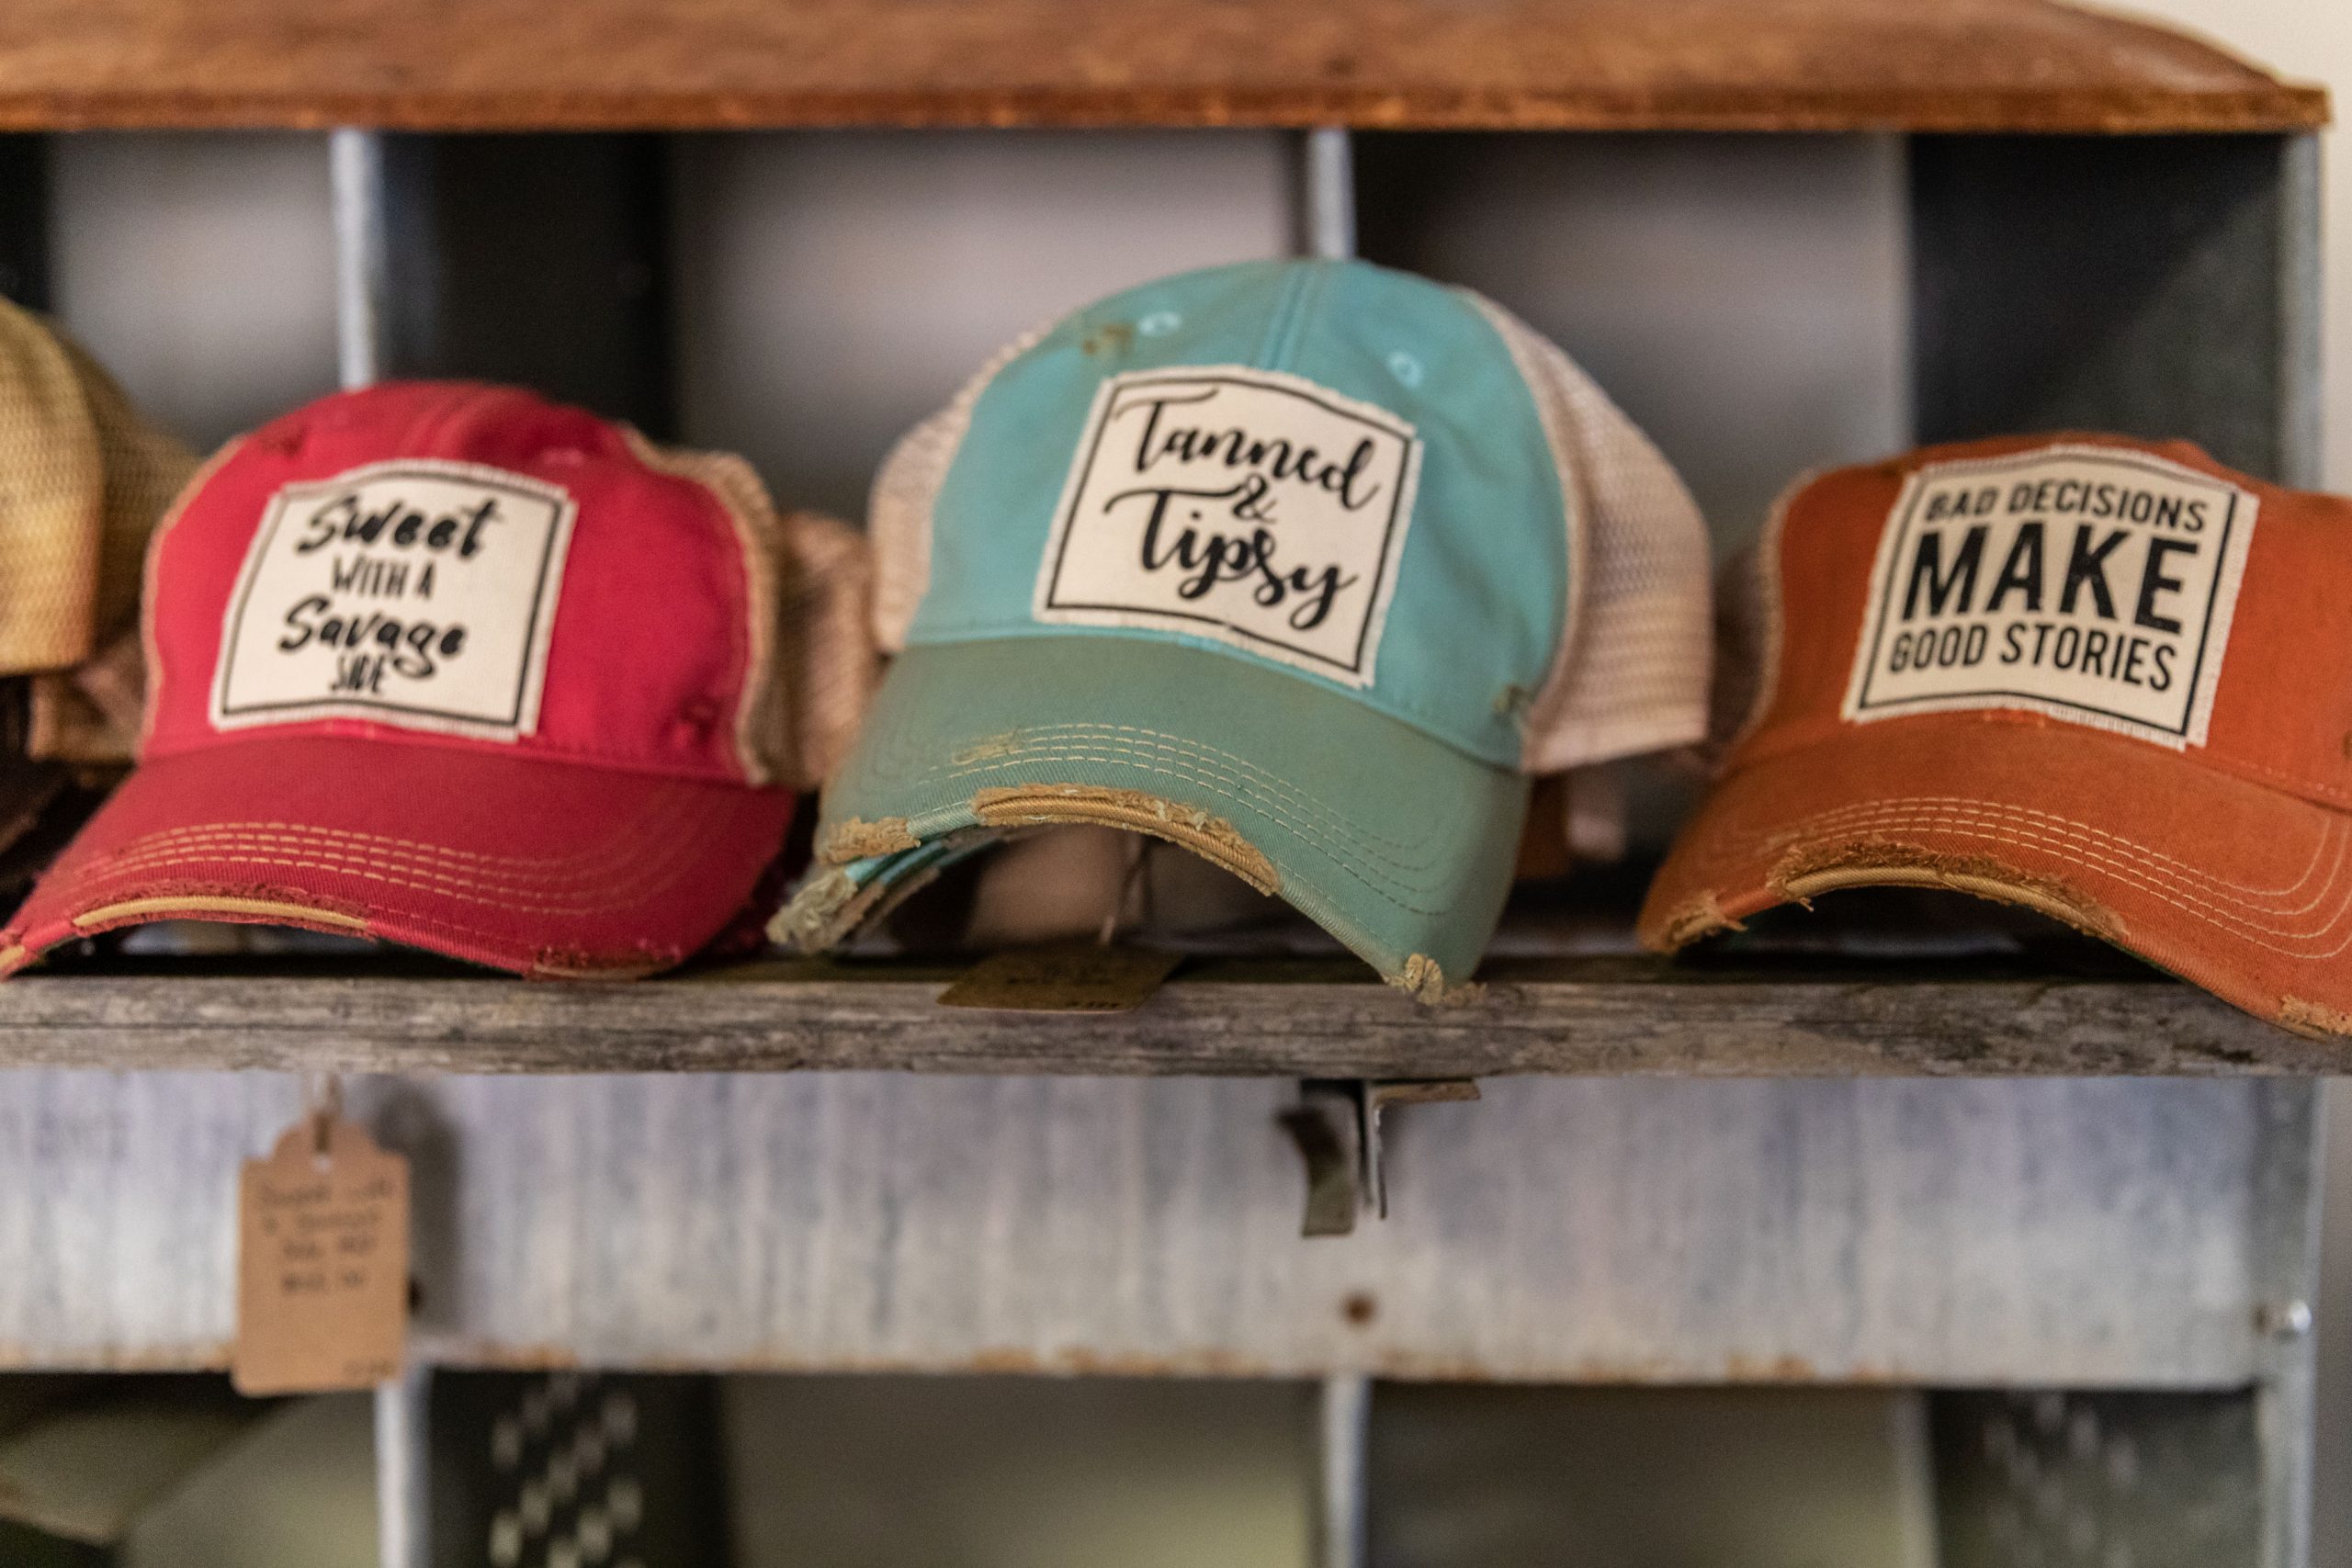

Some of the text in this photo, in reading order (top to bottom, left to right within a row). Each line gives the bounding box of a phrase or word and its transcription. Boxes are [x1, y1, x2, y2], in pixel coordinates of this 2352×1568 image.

[1113, 388, 1380, 511] Tanned
[296, 494, 503, 560] Sweet
[1231, 473, 1277, 525] &
[1925, 479, 2209, 534] BAD DECISIONS
[331, 555, 437, 601] WITH A
[1102, 483, 1360, 631] Tipsy
[1901, 520, 2200, 636] MAKE
[277, 594, 467, 680] Savage
[1889, 622, 2177, 693] GOOD STORIES
